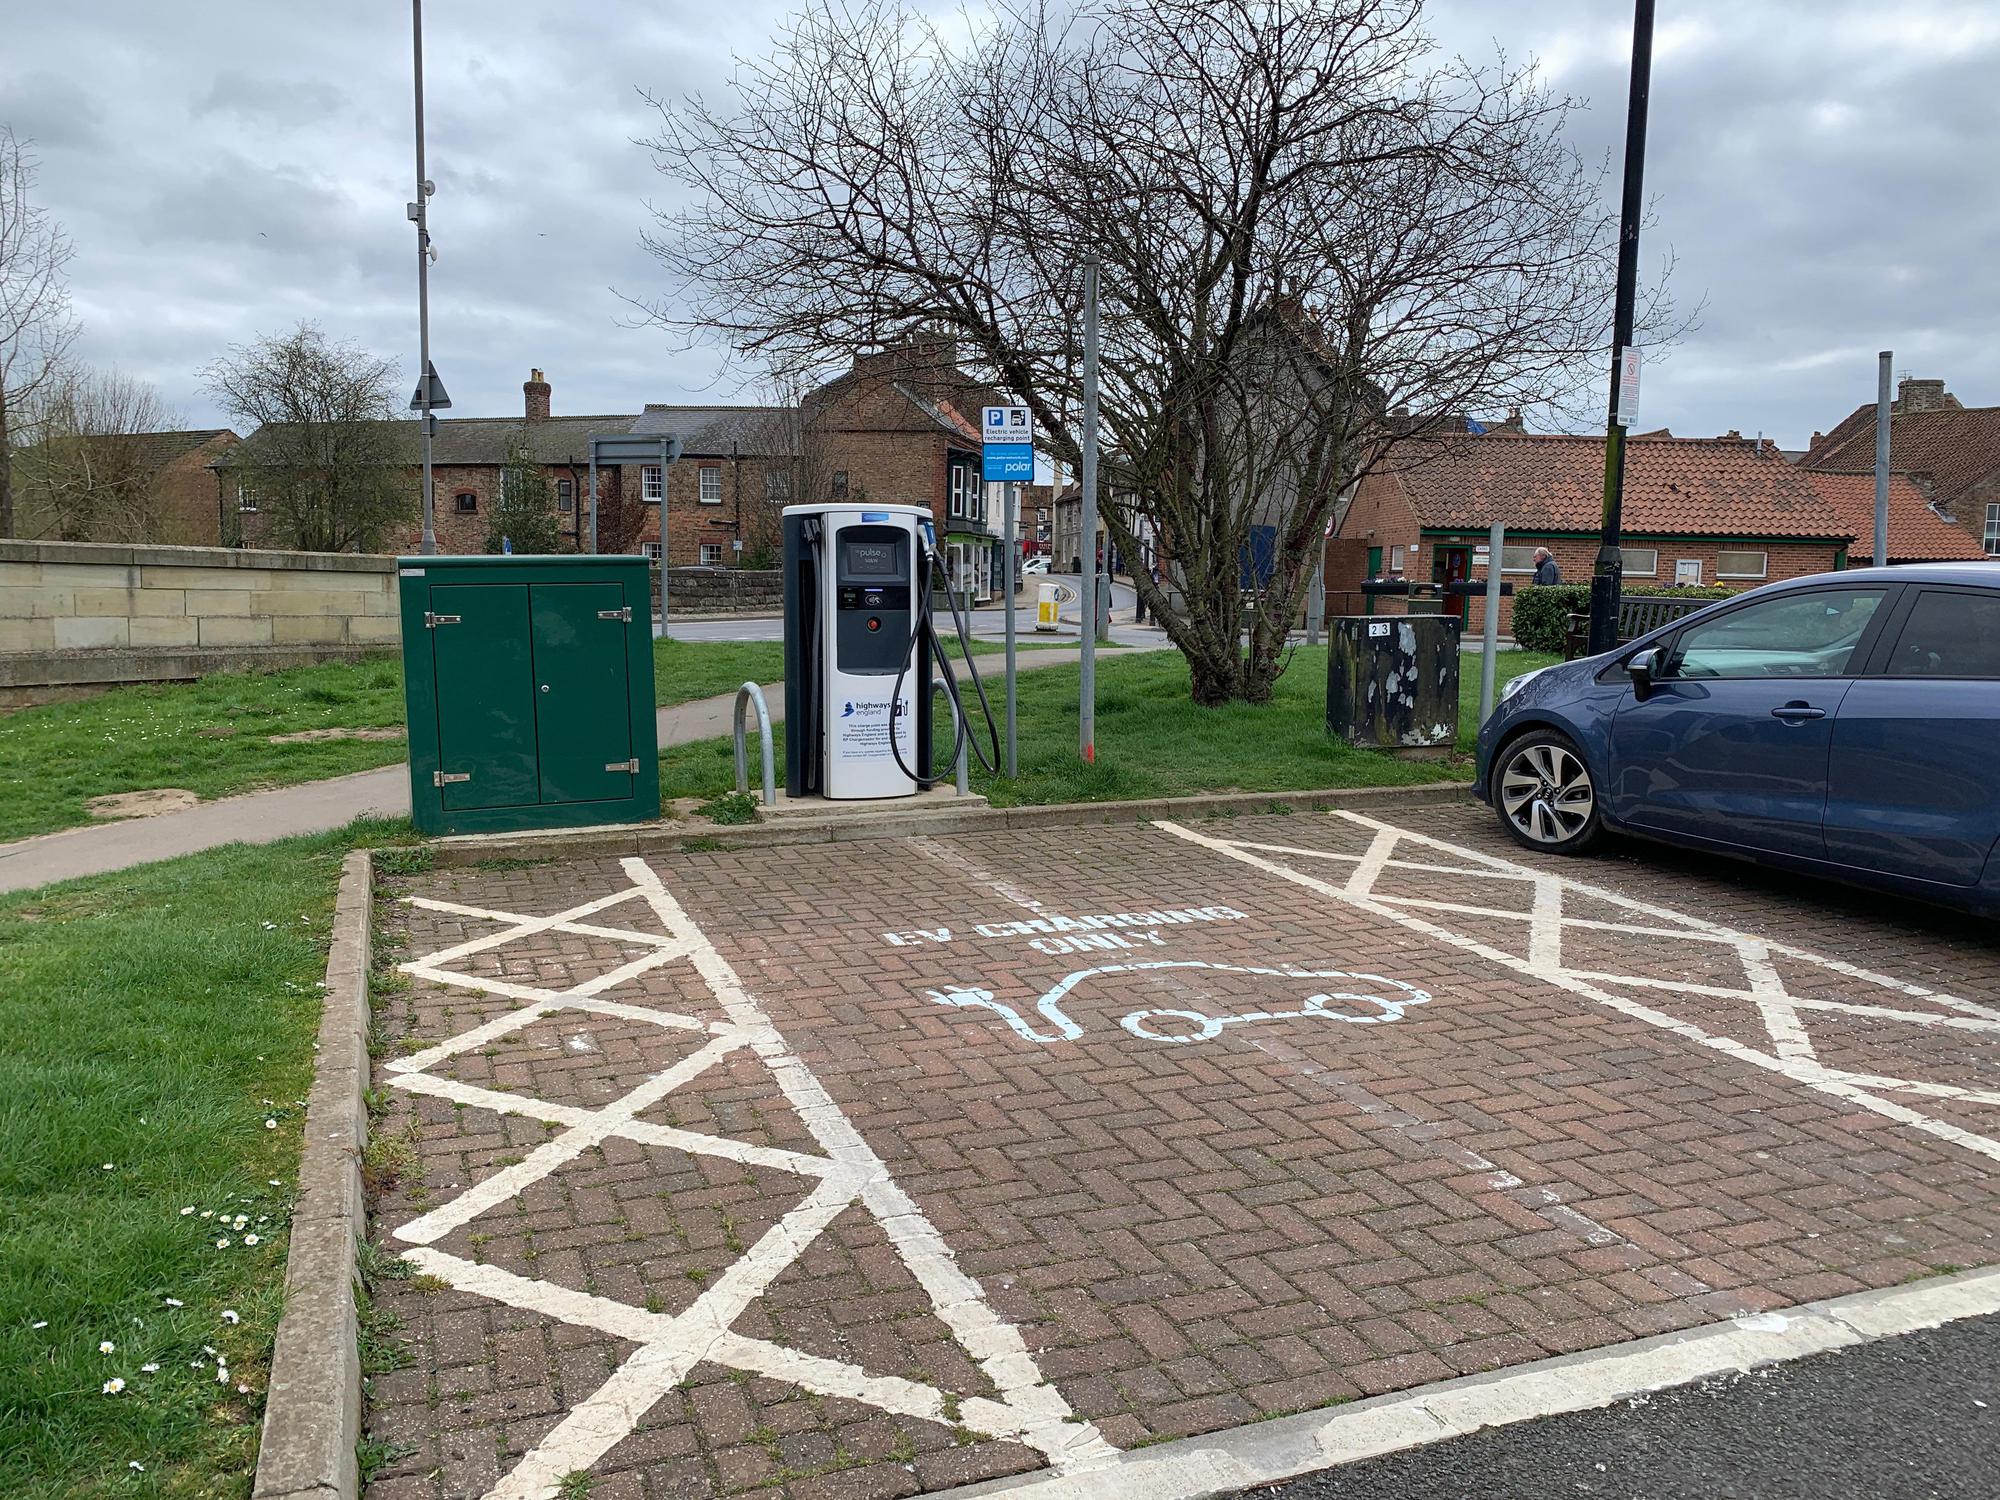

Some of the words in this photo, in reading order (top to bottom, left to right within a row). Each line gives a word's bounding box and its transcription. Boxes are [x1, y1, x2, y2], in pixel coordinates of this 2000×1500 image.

[990, 411, 1001, 424] P
[1005, 461, 1031, 474] polar
[859, 547, 881, 558] pulse
[882, 927, 952, 947] EV
[972, 905, 1251, 938] CHARGING
[1028, 929, 1168, 955] ONLY
